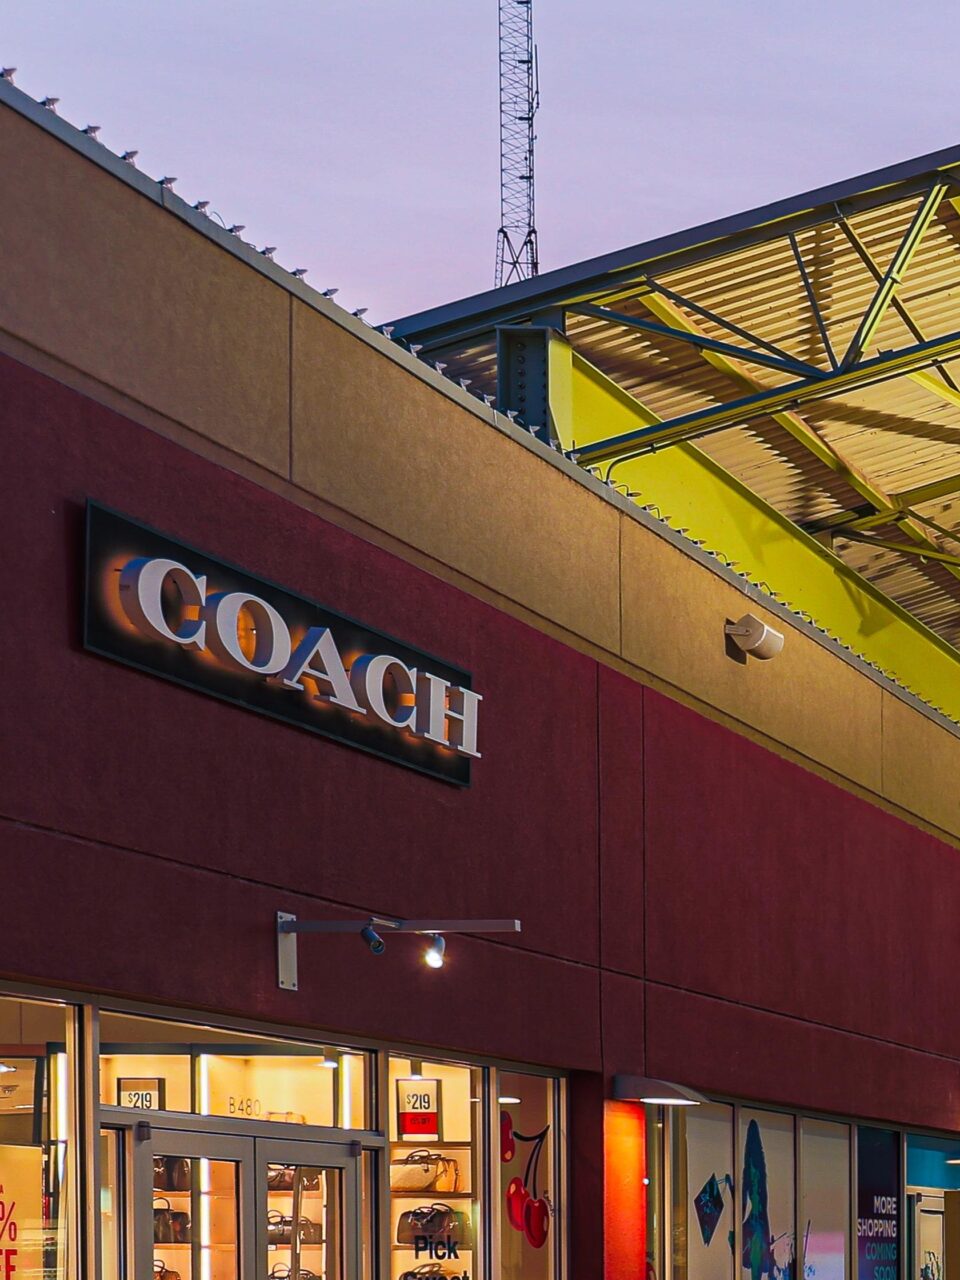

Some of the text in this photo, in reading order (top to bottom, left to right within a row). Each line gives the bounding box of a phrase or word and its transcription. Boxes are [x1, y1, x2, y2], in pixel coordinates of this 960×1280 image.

[134, 558, 483, 758] COACH
[406, 1093, 431, 1110] $219
[873, 1195, 897, 1215] MORE
[857, 1218, 897, 1237] SHOPPING
[414, 1235, 459, 1260] Pick
[865, 1242, 897, 1261] COMING
